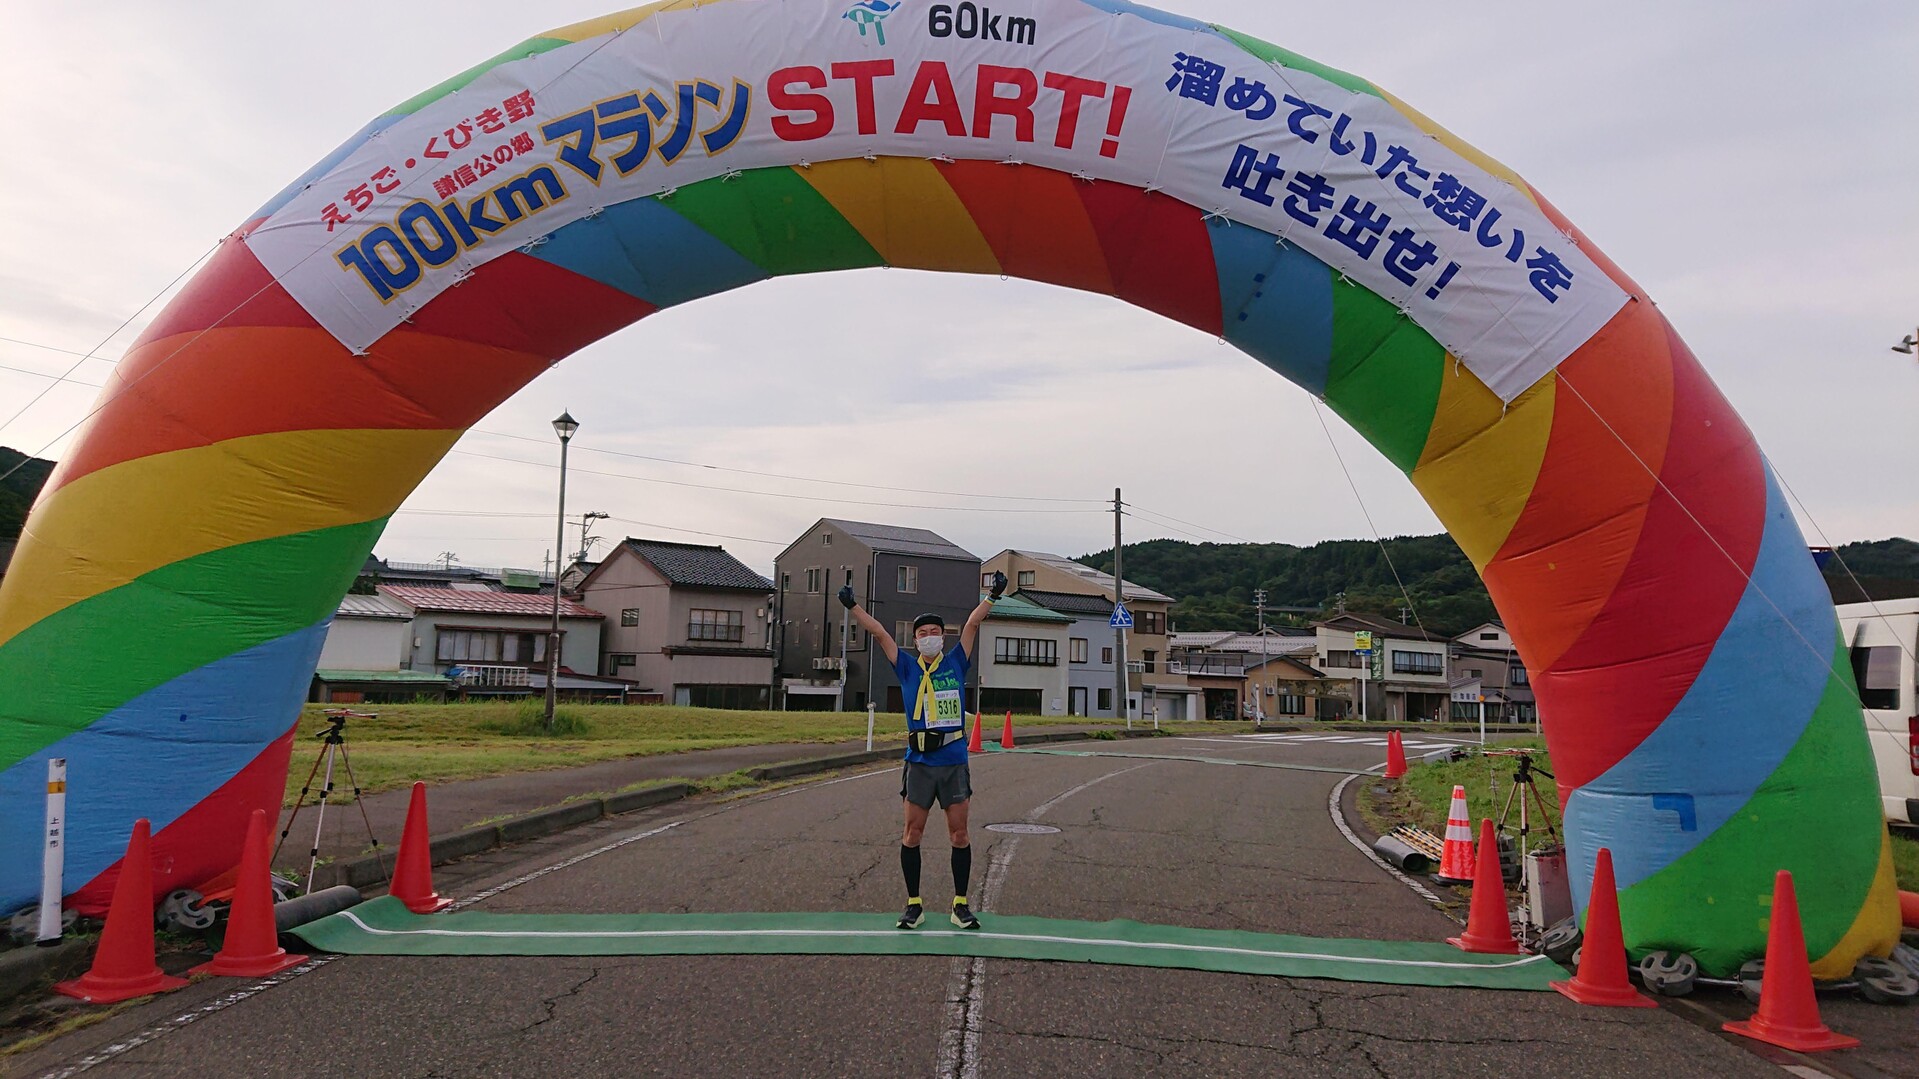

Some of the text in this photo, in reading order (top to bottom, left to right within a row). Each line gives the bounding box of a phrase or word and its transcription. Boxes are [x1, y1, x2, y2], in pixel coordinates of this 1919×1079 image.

[928, 1, 1036, 46] 60km
[767, 58, 1132, 159] START!
[320, 89, 536, 232] えちご・くびき野
[432, 131, 535, 200] 謙信公の郷
[1165, 52, 1574, 304] 溜めていた想いを
[938, 699, 958, 715] 5316
[49, 816, 60, 849] 上越市
